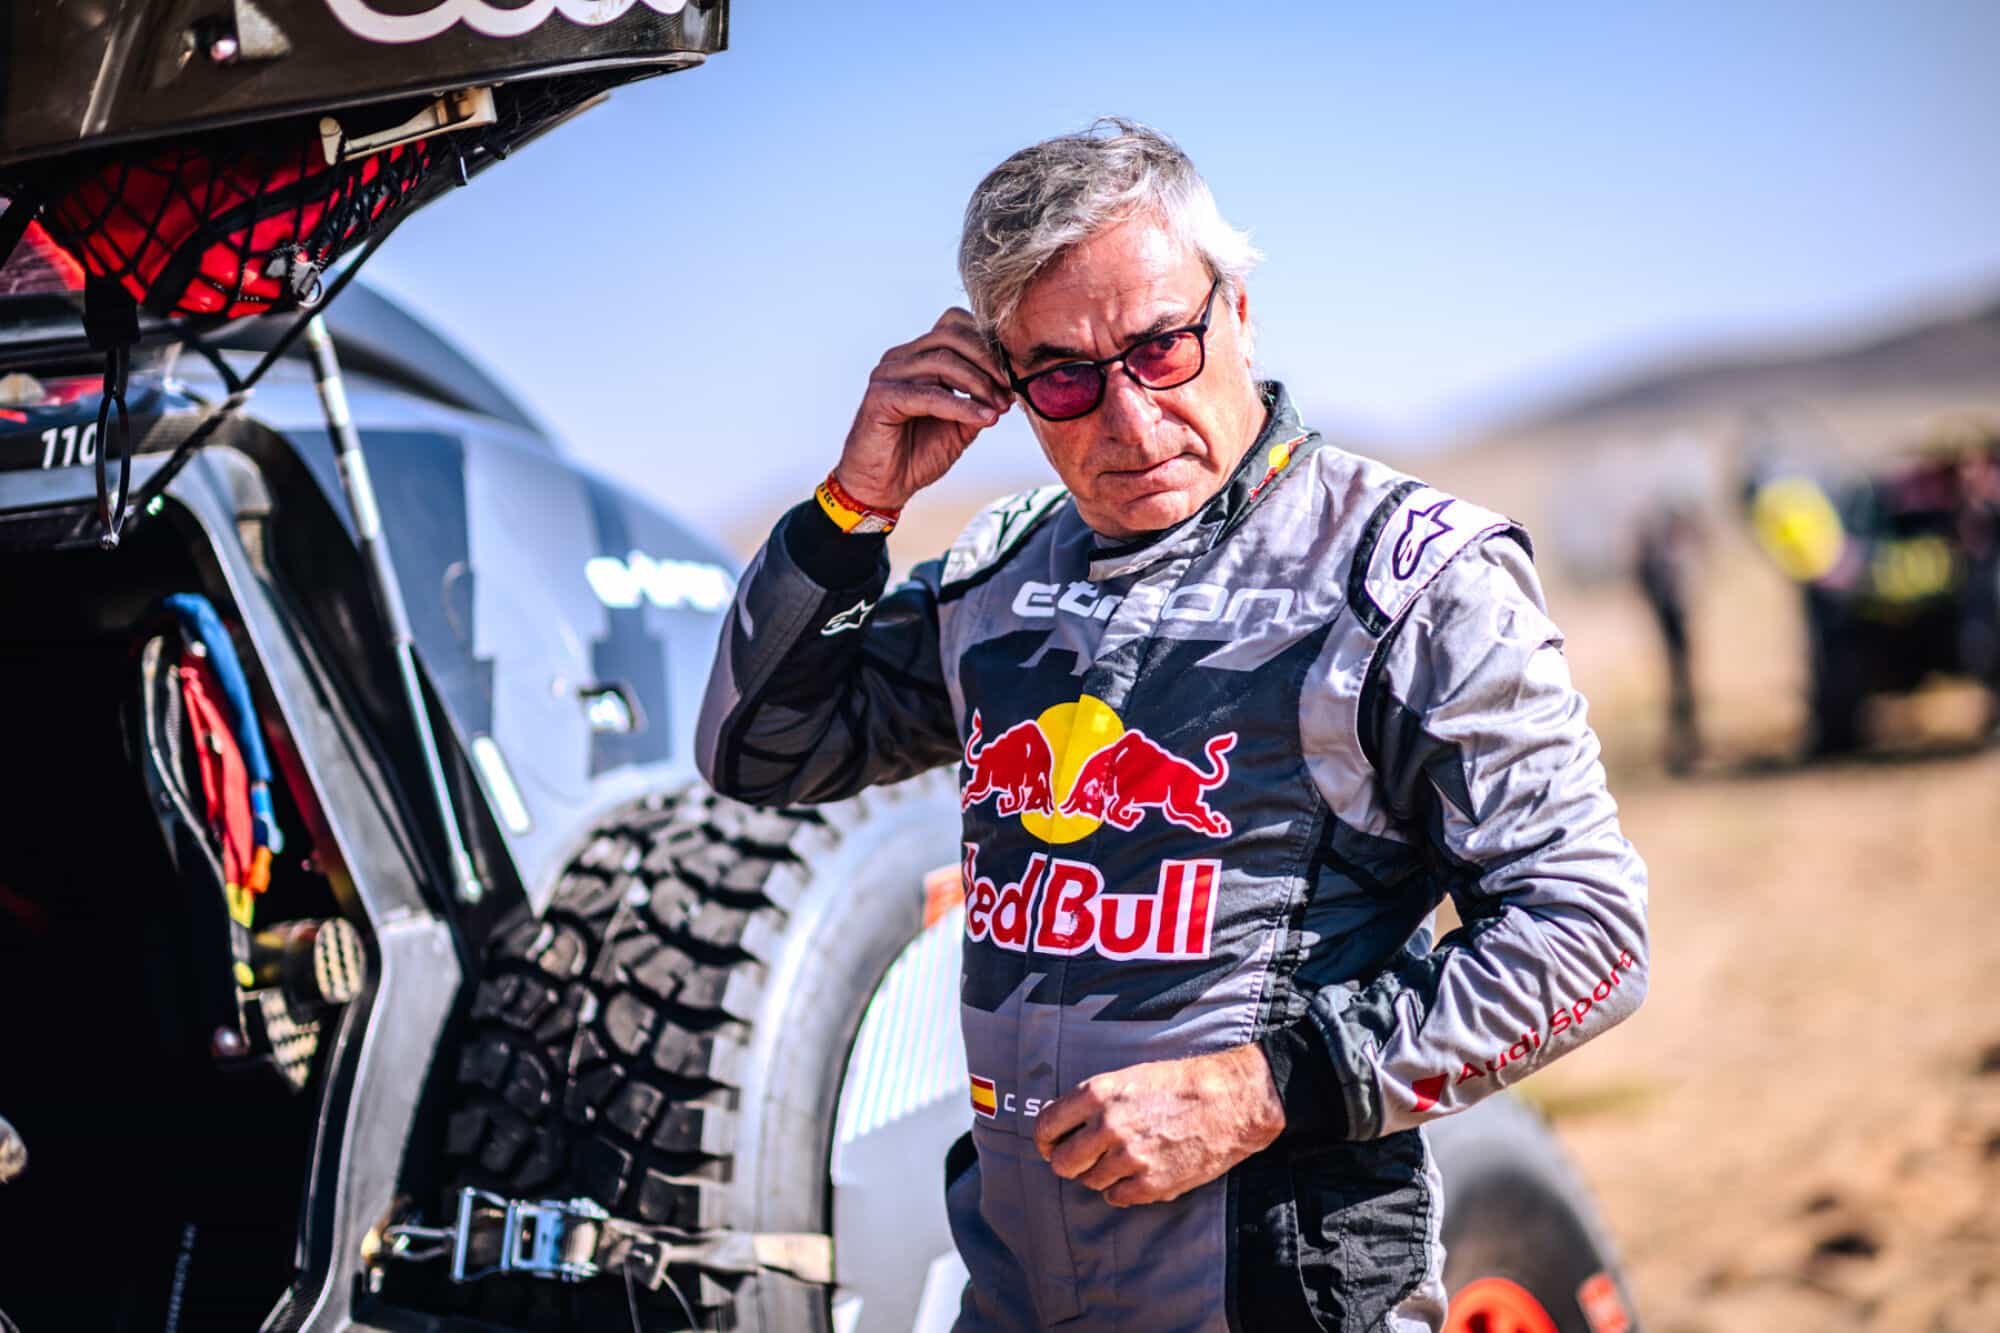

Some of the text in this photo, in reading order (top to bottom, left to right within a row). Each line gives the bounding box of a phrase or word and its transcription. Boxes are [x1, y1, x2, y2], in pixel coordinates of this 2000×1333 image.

[41, 422, 99, 470] 110
[963, 841, 1223, 961] ed Bull
[1455, 950, 1635, 1085] Audi Sport
[1003, 1092, 1056, 1117] C S
